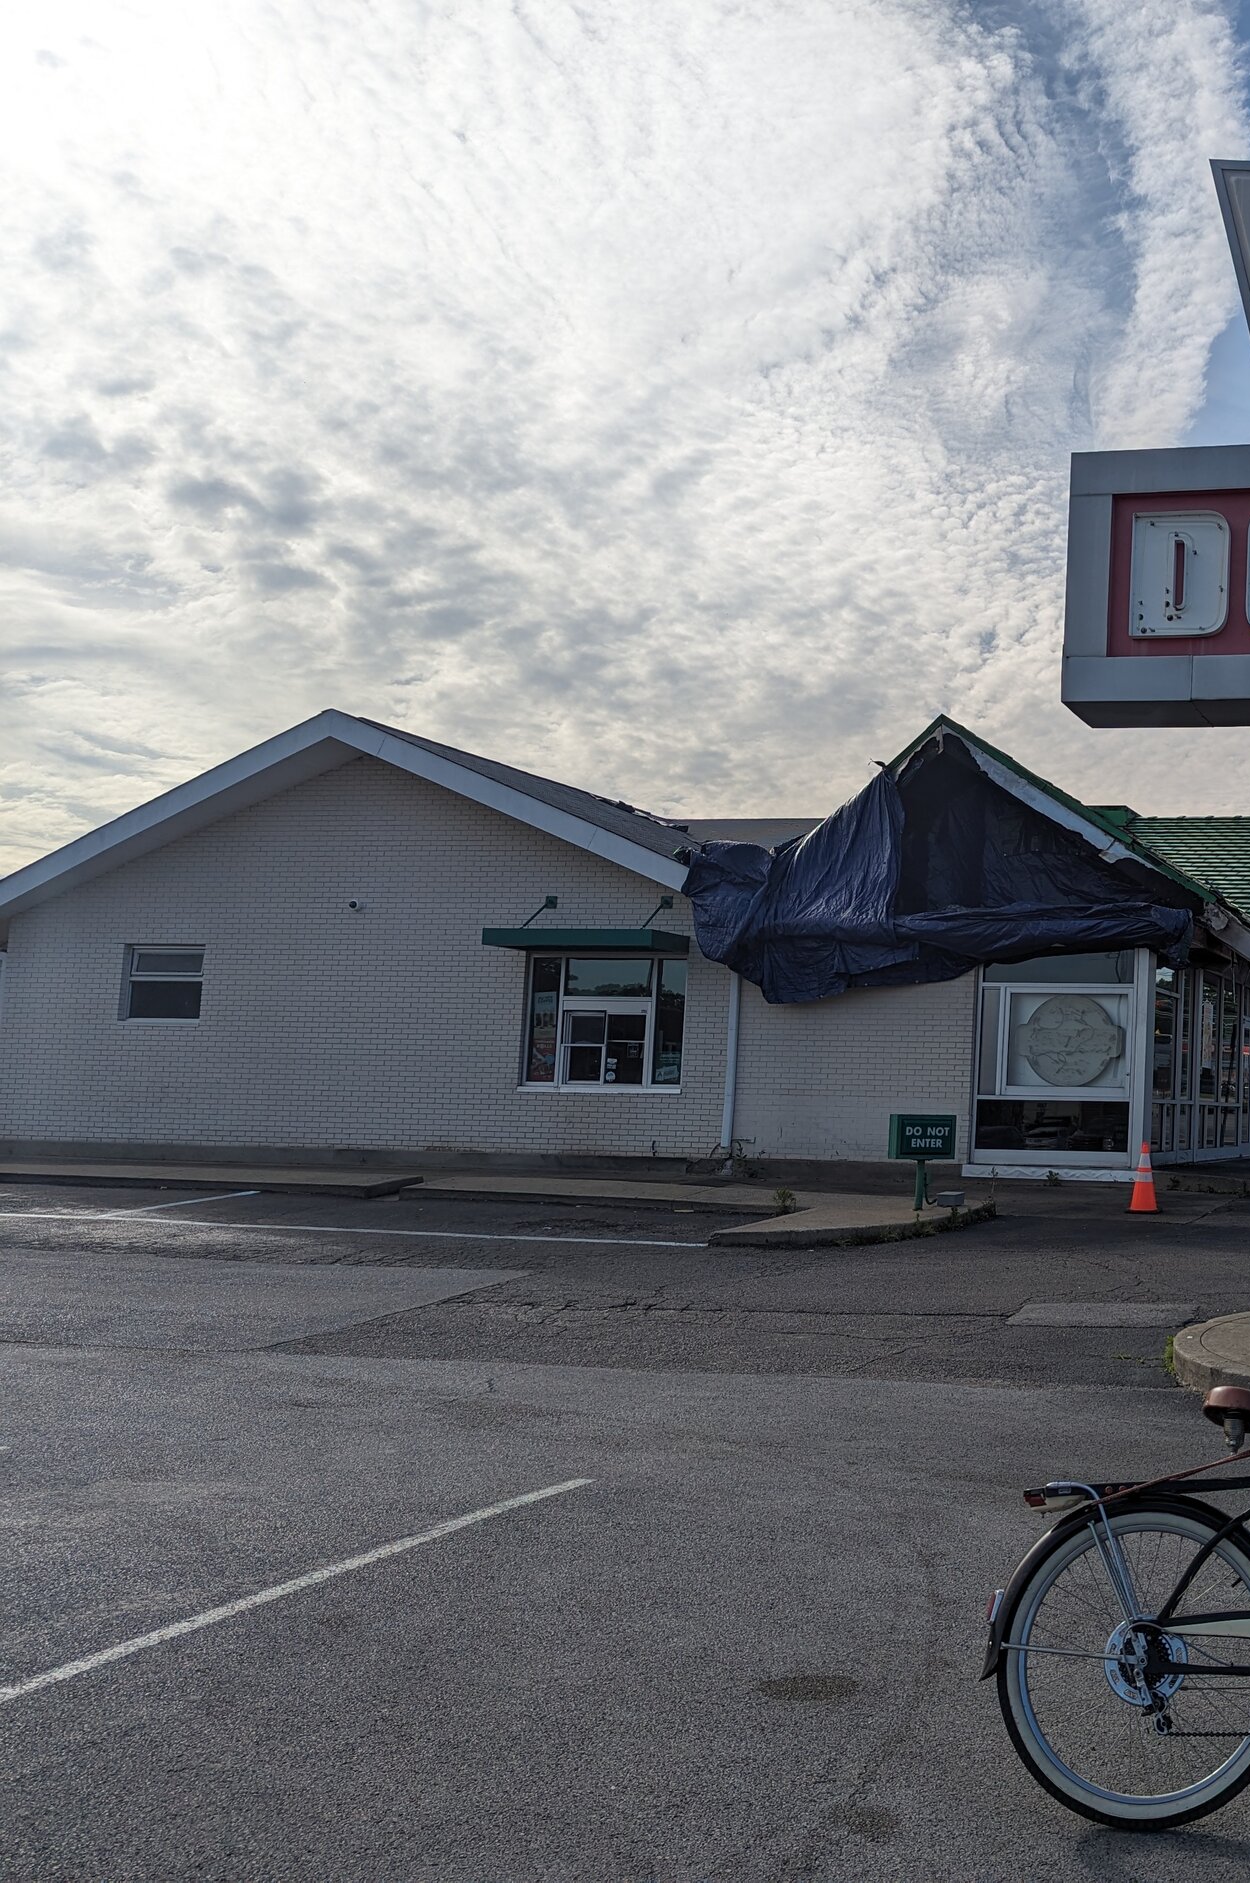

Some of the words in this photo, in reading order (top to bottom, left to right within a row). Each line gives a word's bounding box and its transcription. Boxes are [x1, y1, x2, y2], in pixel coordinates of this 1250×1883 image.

[906, 1126, 922, 1136] DO
[927, 1127, 950, 1136] NOT
[911, 1138, 942, 1148] ENTER
